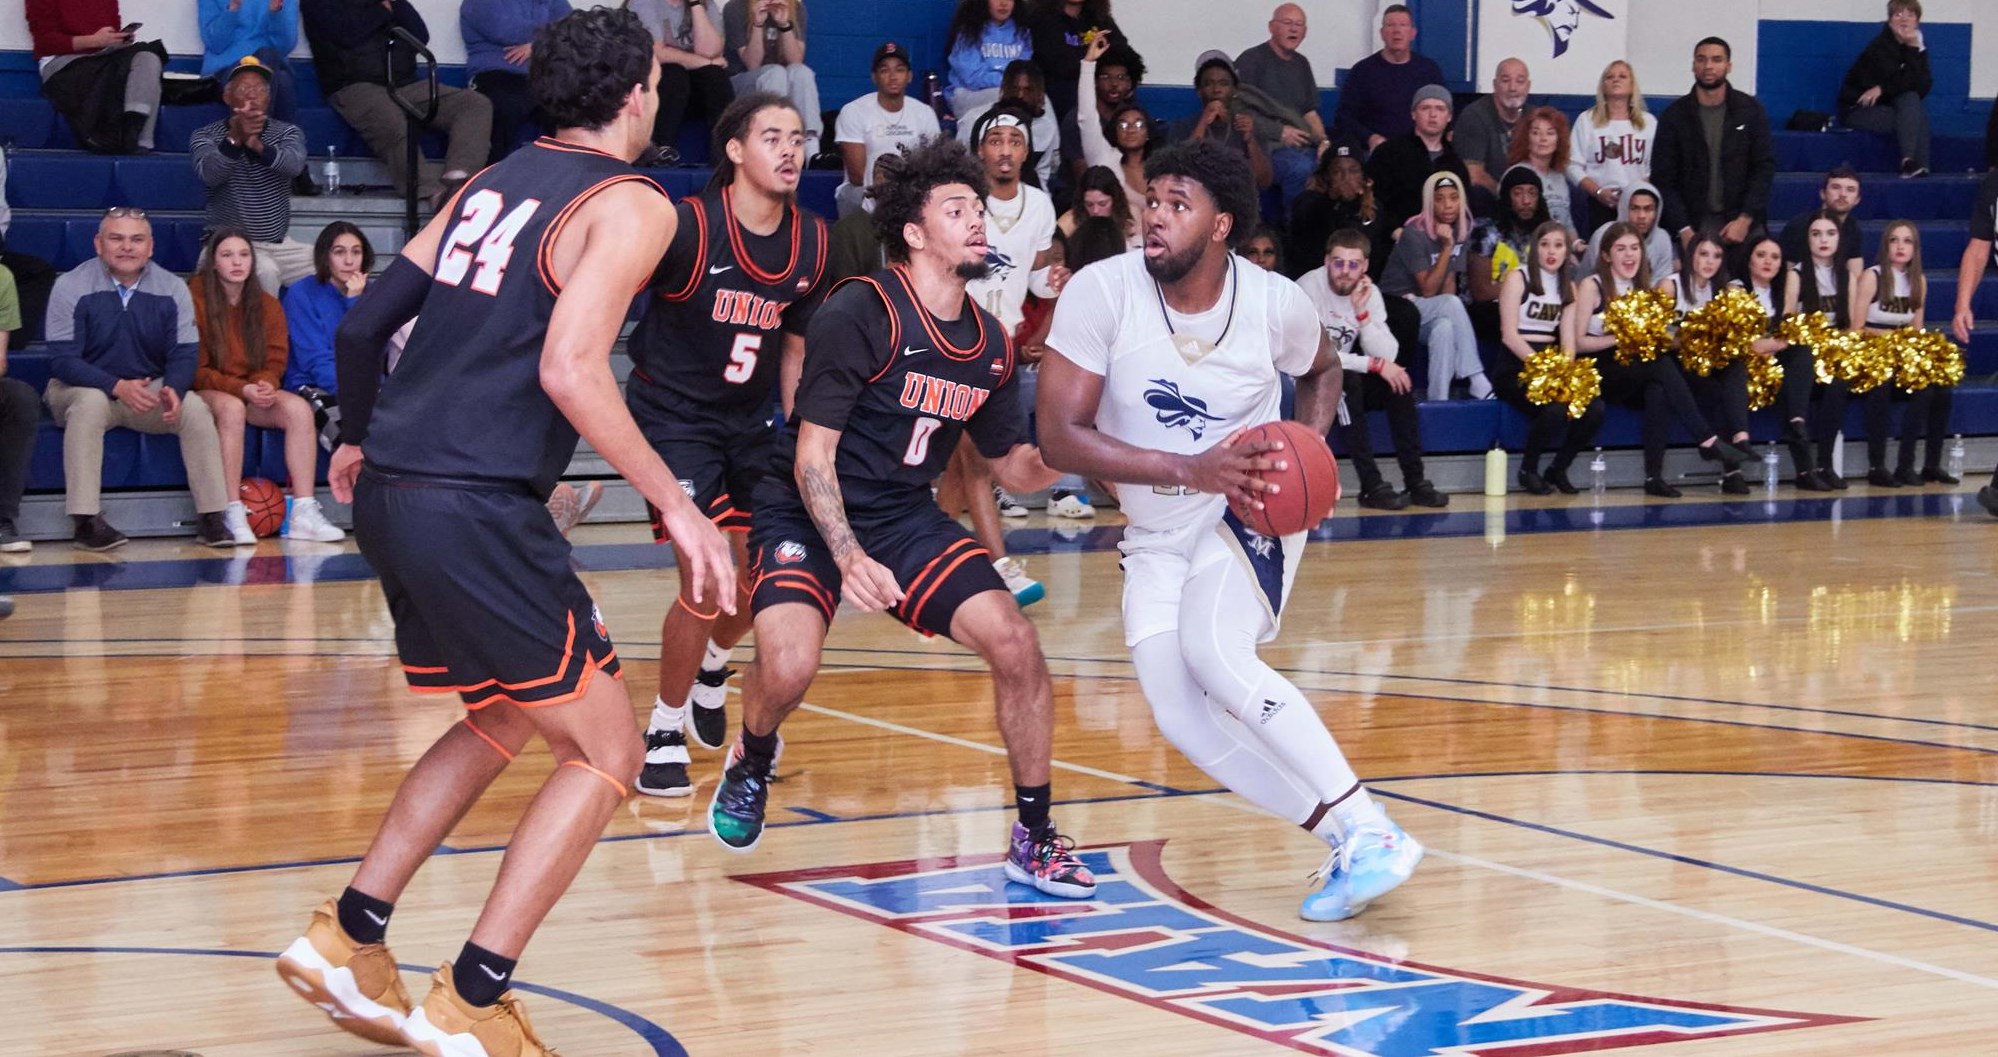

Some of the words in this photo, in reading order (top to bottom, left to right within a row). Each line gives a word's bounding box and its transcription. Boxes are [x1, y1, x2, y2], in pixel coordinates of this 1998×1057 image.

[434, 188, 542, 297] 24
[1527, 301, 1561, 321] CAV
[723, 332, 762, 384] 5
[900, 371, 990, 422] UNION
[903, 416, 942, 466] 0
